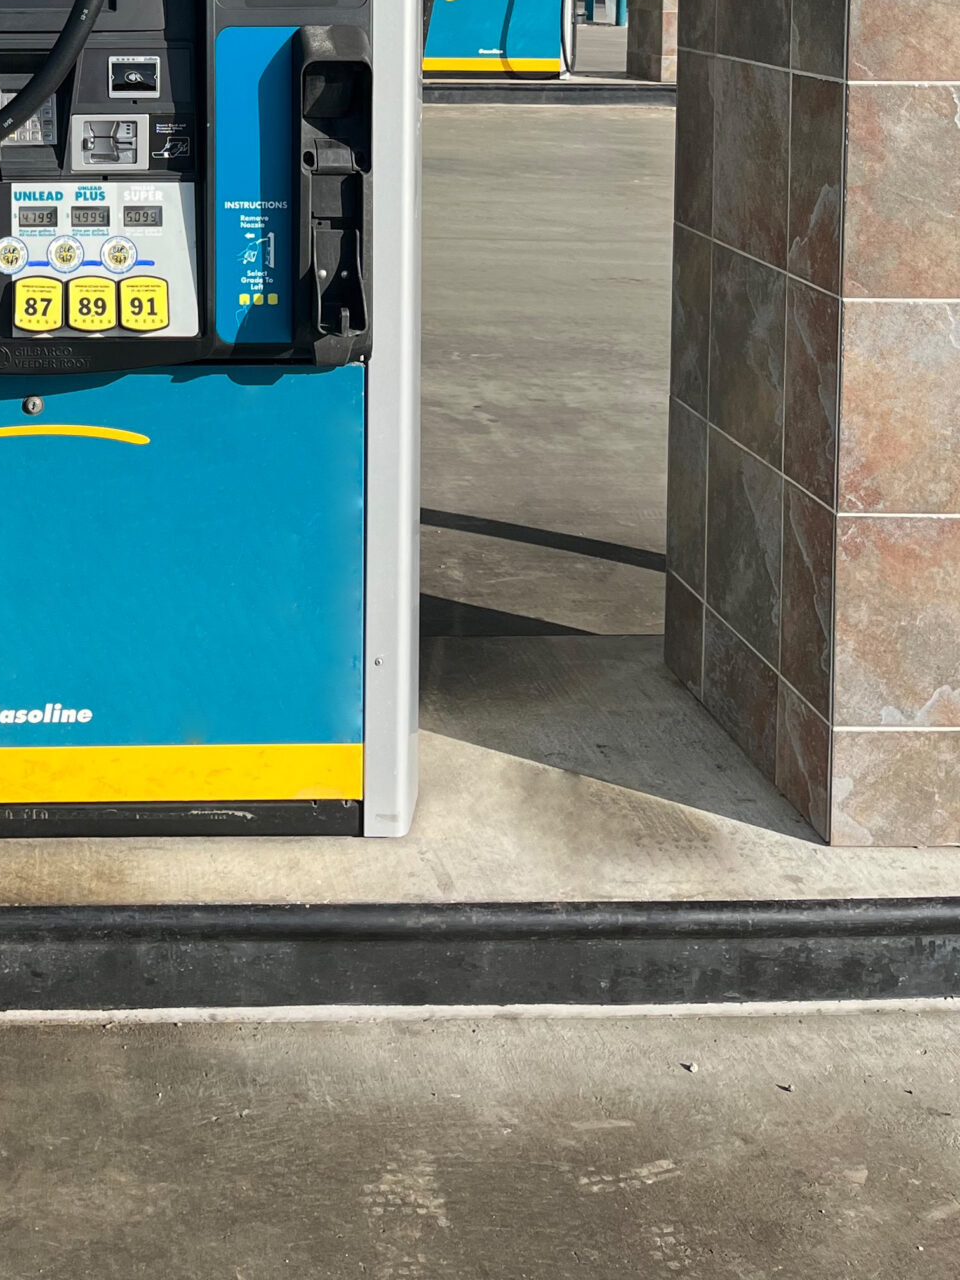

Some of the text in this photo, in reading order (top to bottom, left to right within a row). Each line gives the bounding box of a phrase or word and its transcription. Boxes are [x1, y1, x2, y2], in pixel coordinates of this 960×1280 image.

[13, 191, 64, 202] UNLEAD
[75, 191, 106, 201] PLUS
[123, 190, 164, 200] SUPER
[224, 201, 288, 209] INSTRUCTIONS
[24, 297, 53, 317] 87
[78, 297, 107, 317] 89
[130, 297, 158, 317] 91
[14, 346, 73, 357] GILBARCO
[14, 359, 56, 369] VEEDER
